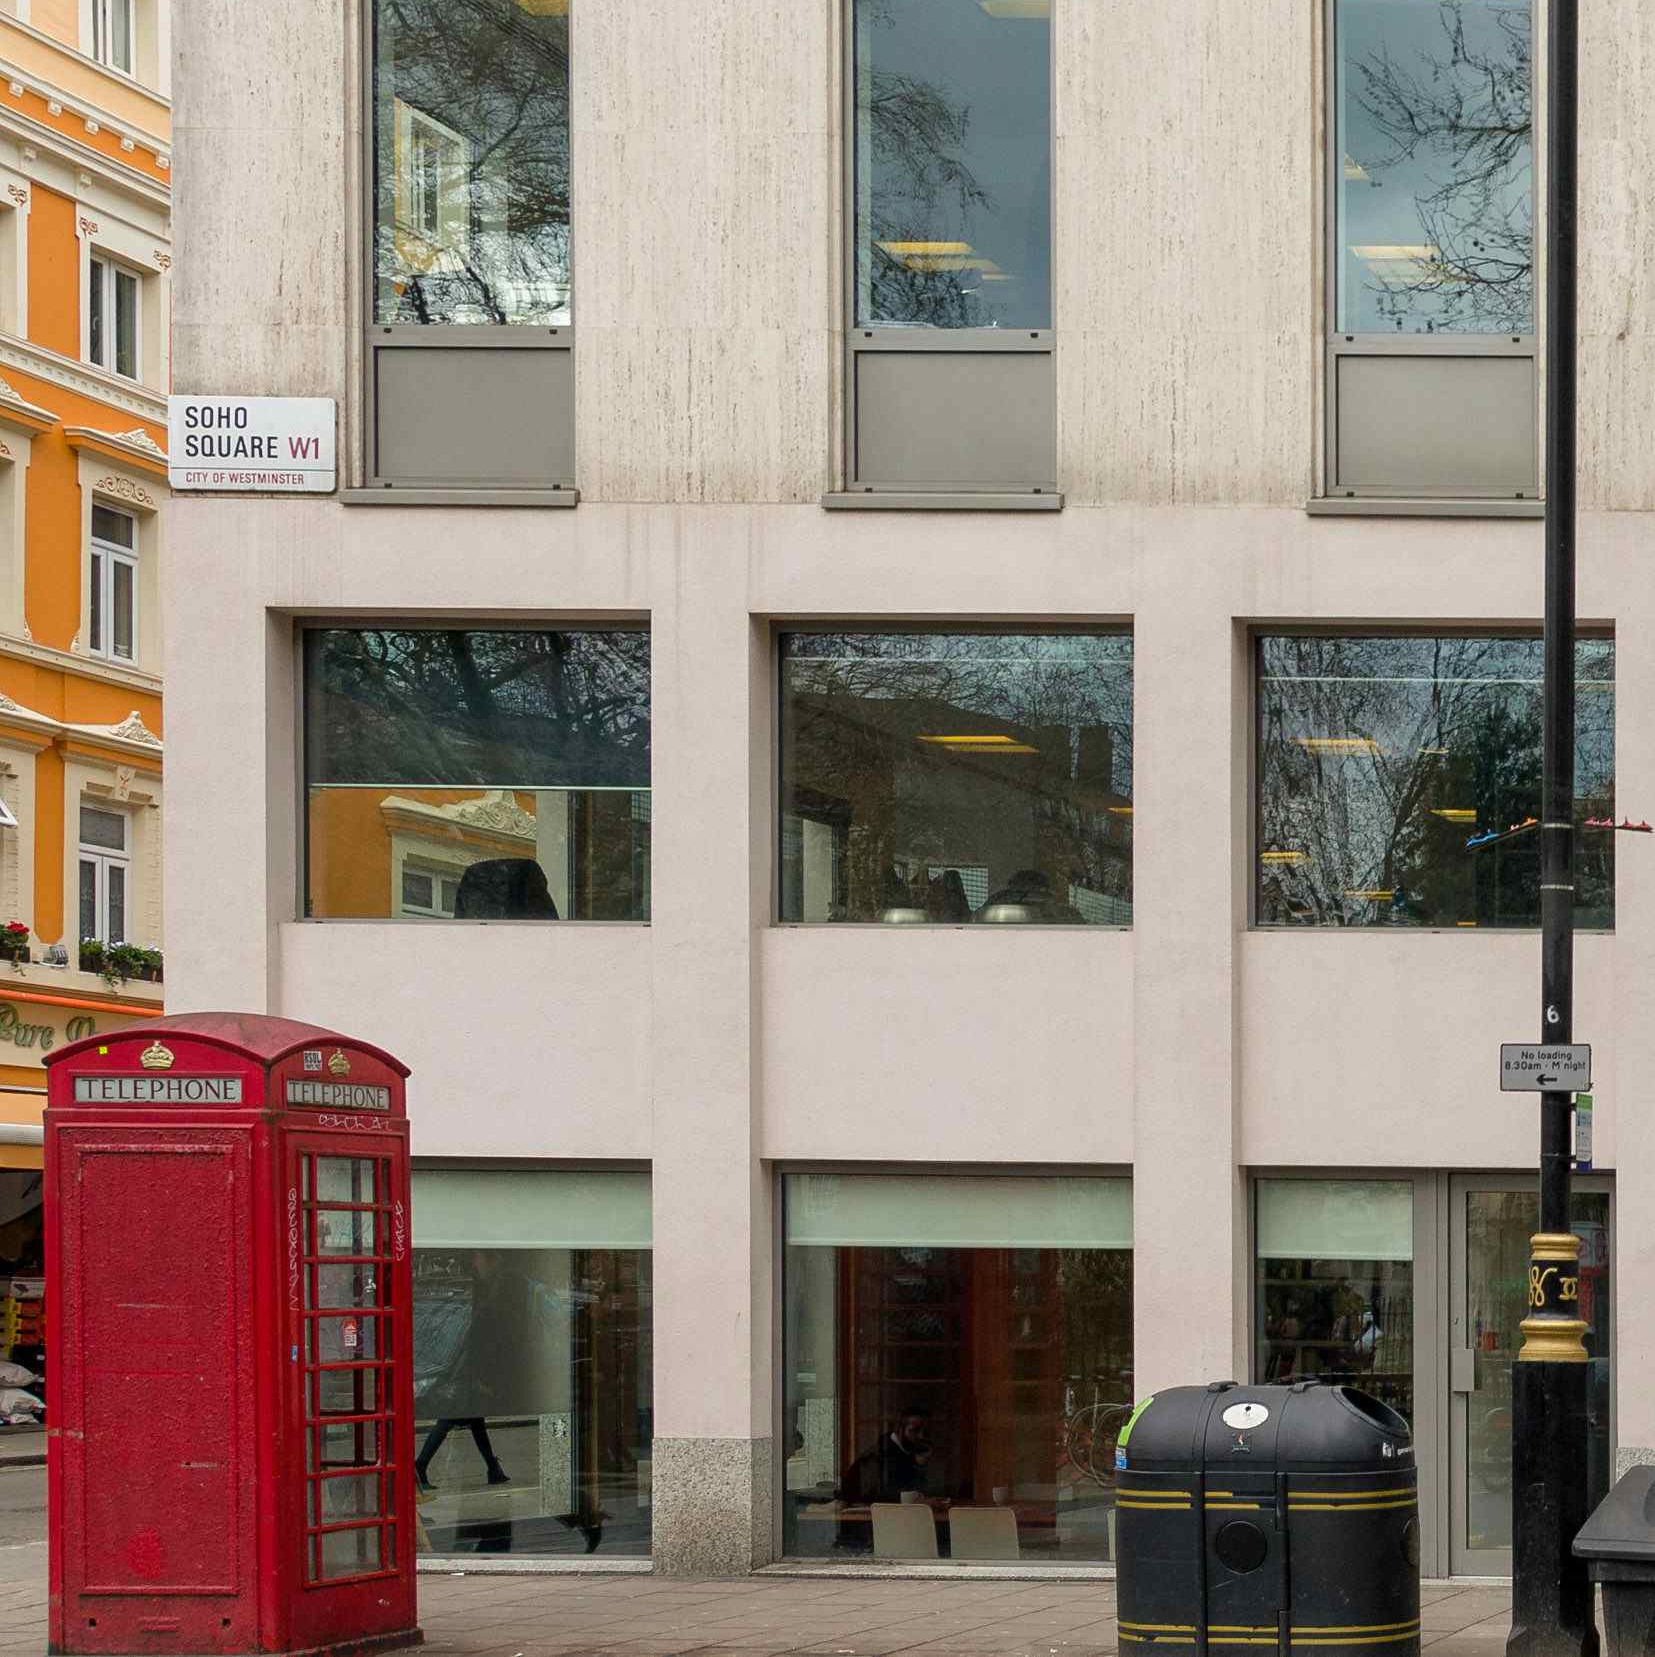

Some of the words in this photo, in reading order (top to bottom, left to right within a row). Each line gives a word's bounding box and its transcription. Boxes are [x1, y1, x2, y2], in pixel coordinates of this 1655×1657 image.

[185, 406, 247, 429] SOHO
[185, 435, 279, 458] SQUARE
[288, 437, 320, 459] W1
[186, 472, 208, 483] CITY
[213, 472, 225, 483] OF
[229, 473, 304, 485] WESTMINSTER
[1547, 1005, 1560, 1024] 6
[1504, 1061, 1542, 1071] 8.30am
[1521, 1051, 1535, 1060] No
[1538, 1051, 1573, 1062] loading
[82, 1079, 236, 1100] TELEPHONE
[288, 1082, 386, 1108] TELEPHONE
